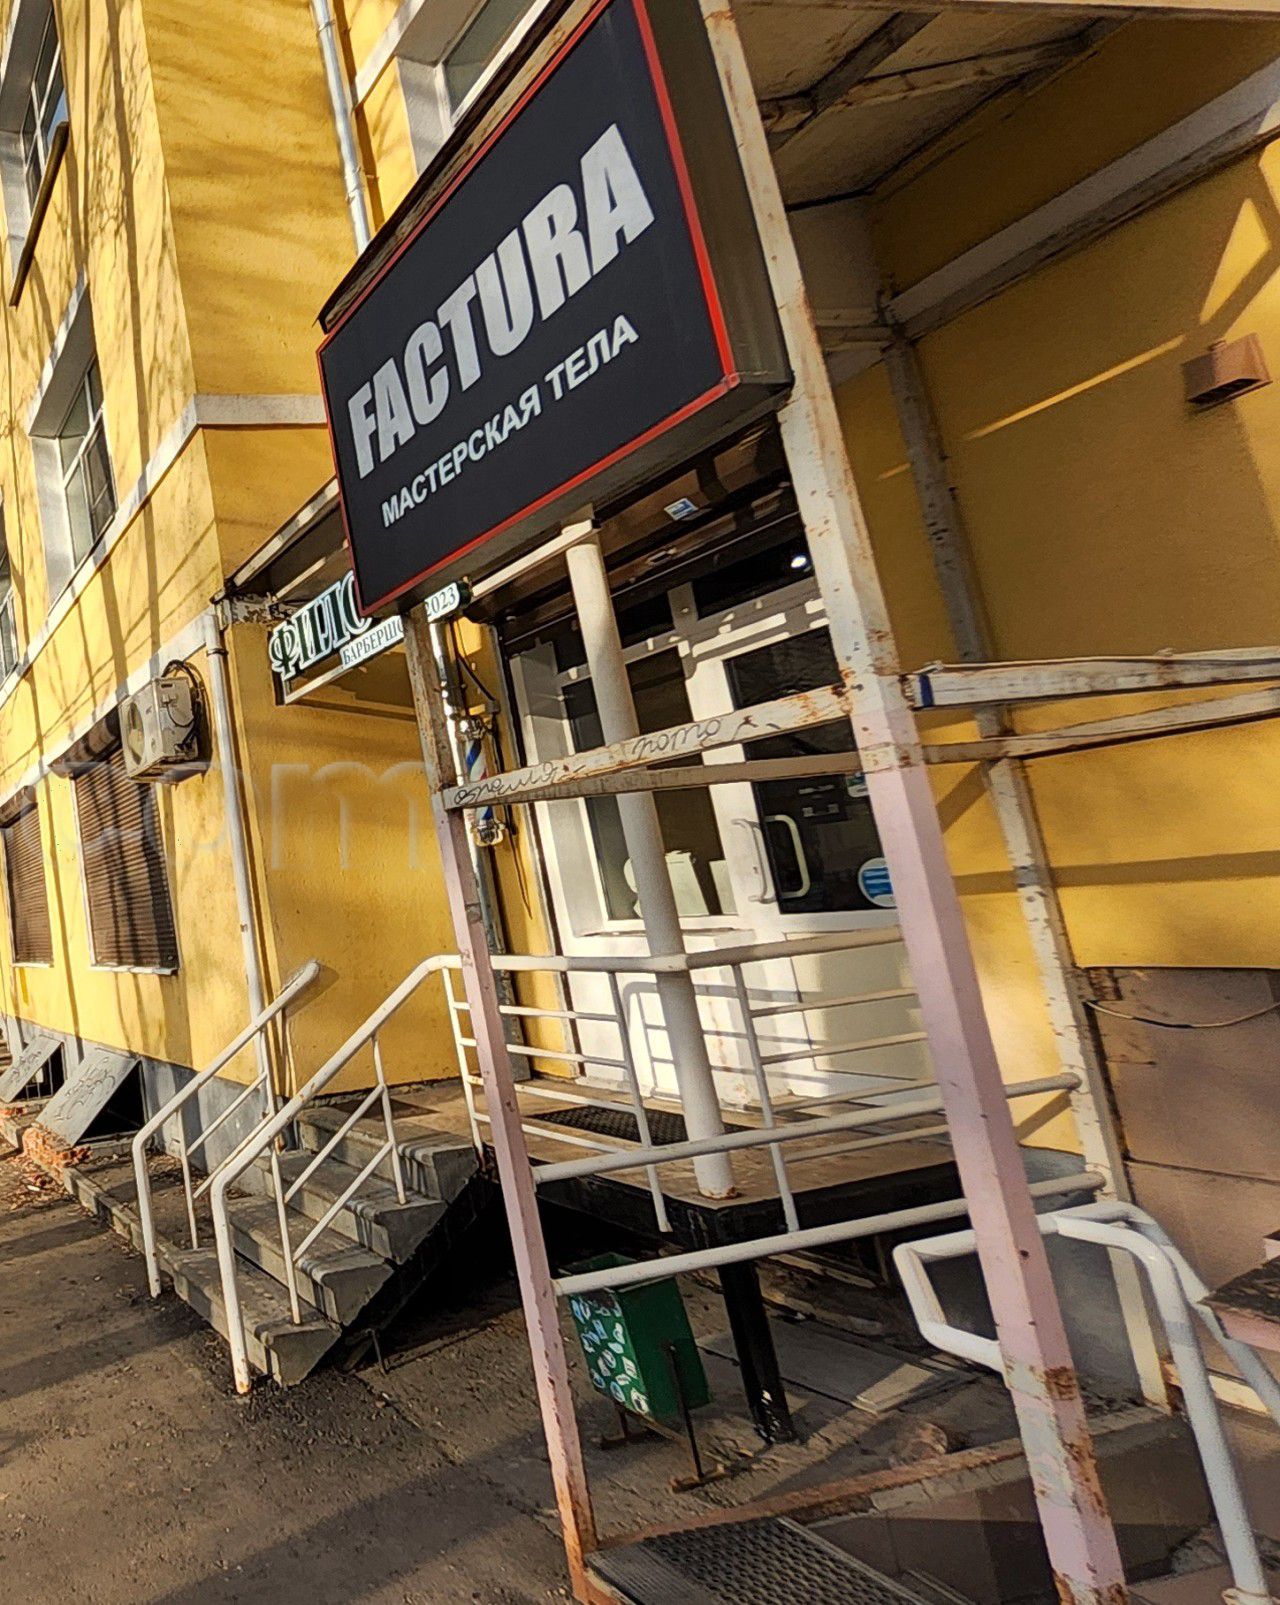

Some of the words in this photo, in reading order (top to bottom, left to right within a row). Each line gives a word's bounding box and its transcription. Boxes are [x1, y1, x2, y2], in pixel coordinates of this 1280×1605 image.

[348, 123, 654, 479] FACTURA
[382, 386, 541, 527] МАСТЕРСКАЯ
[545, 314, 638, 402] ТЕЛА
